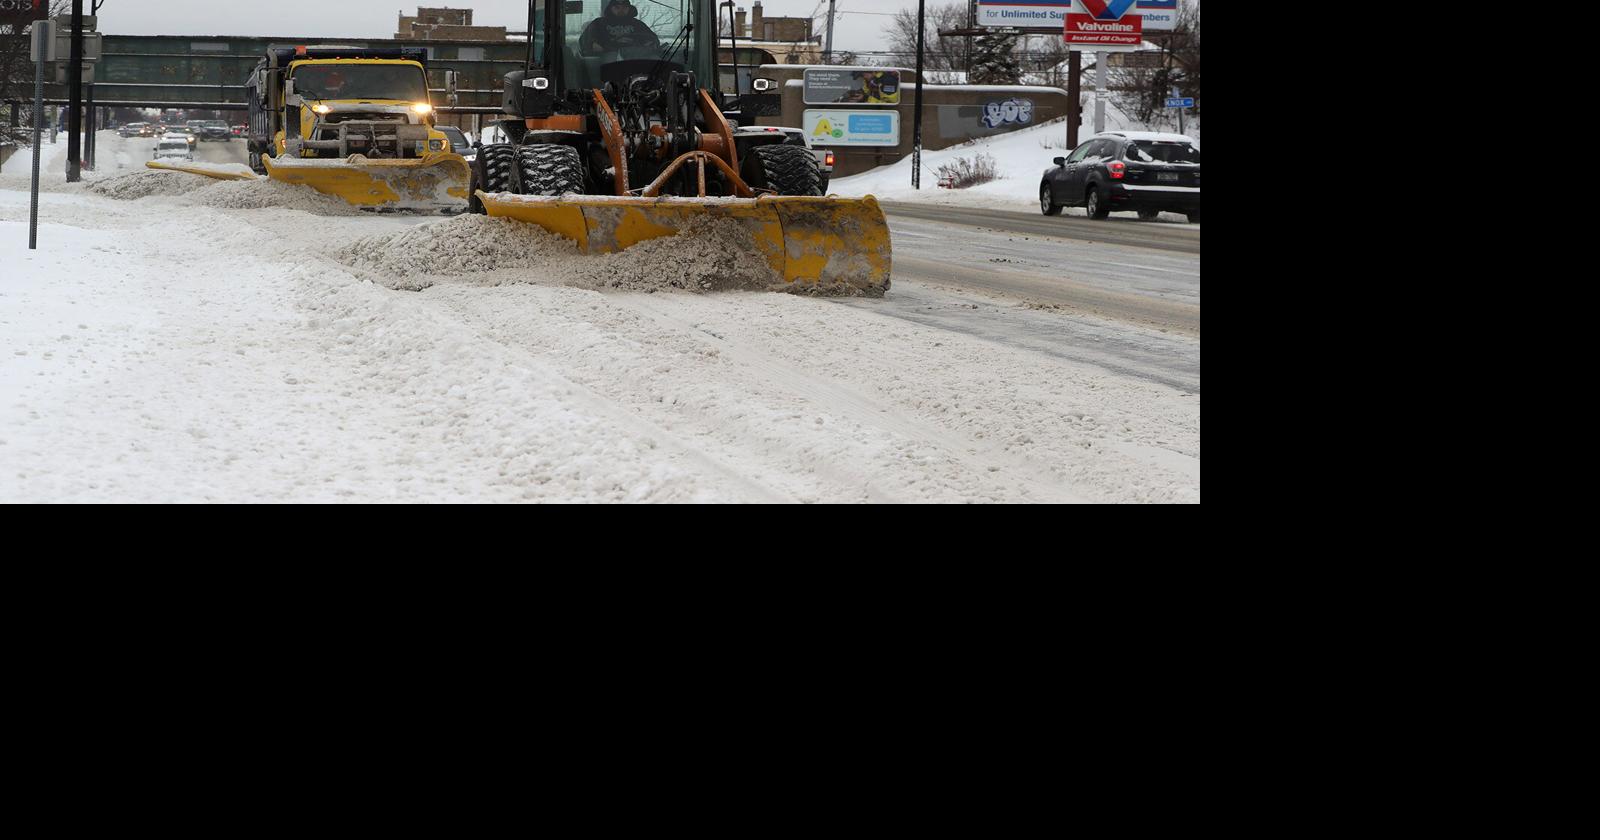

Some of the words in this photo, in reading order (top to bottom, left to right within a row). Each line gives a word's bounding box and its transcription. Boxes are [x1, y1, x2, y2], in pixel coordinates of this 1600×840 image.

[986, 10, 998, 18] for
[1001, 10, 1047, 19] Unlimited
[1141, 14, 1170, 22] mbers
[1076, 21, 1134, 32] Valvoline
